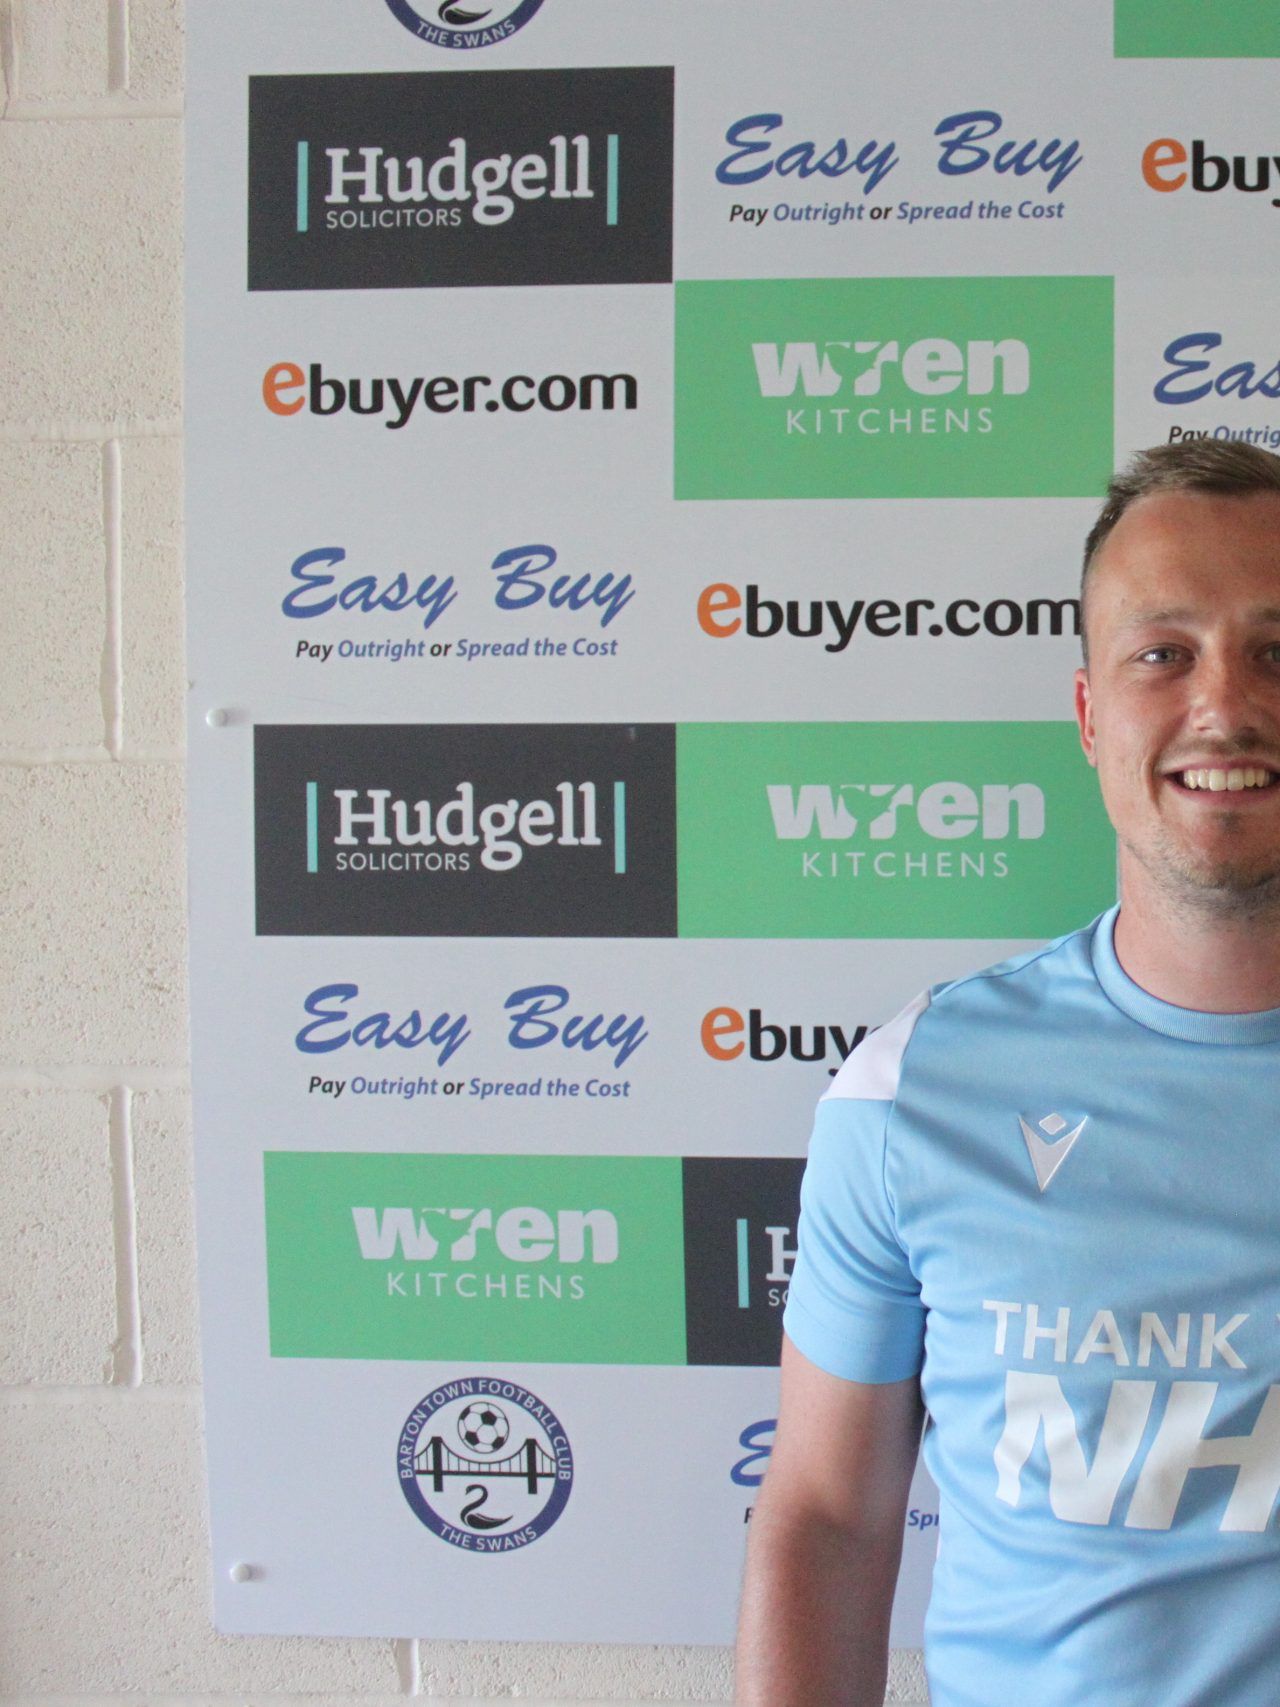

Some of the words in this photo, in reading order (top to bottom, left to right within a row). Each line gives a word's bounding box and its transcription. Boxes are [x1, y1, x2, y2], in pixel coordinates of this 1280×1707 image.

[415, 20, 449, 46] THE
[452, 19, 516, 48] SWANS
[325, 135, 594, 228] Hudgell
[716, 114, 899, 195] Easy
[934, 111, 1082, 193] Buy
[326, 207, 462, 230] SOLICITORS
[729, 204, 769, 227] Pay
[773, 201, 866, 226] Outright
[869, 206, 893, 221] or
[896, 200, 974, 225] Spread
[977, 200, 1013, 220] the
[1017, 200, 1065, 219] Cost
[262, 362, 638, 430] ebuyer.com
[752, 338, 1030, 397] wren
[785, 407, 993, 435] KITCHENS
[282, 547, 458, 629] Easy
[491, 545, 635, 628] Buy
[697, 583, 1081, 656] ebuyer.com
[295, 639, 334, 663] Pay
[337, 638, 426, 663] Outright
[429, 643, 453, 657] or
[455, 637, 530, 662] Spread
[534, 637, 568, 657] the
[572, 637, 619, 657] Cost
[334, 782, 601, 871] Hudgell
[766, 781, 1045, 839] wren
[335, 851, 471, 872] SOLICITORS
[801, 851, 1009, 878] KITCHENS
[295, 984, 471, 1066] Easy
[504, 985, 648, 1068] Buy
[308, 1075, 347, 1099] Pay
[350, 1076, 439, 1100] Outright
[442, 1081, 465, 1096] or
[468, 1077, 543, 1101] Spread
[546, 1077, 581, 1097] the
[584, 1078, 631, 1098] Cost
[352, 1207, 618, 1263] wren
[386, 1271, 585, 1301] KITCHENS
[984, 1300, 1248, 1370] THANK
[400, 1410, 428, 1480] BARTON
[422, 1380, 474, 1412] TOWN
[478, 1379, 558, 1434] FOOTBALL
[552, 1434, 572, 1481] CLUB
[440, 1523, 471, 1548] THE
[476, 1526, 537, 1551] SWANS
